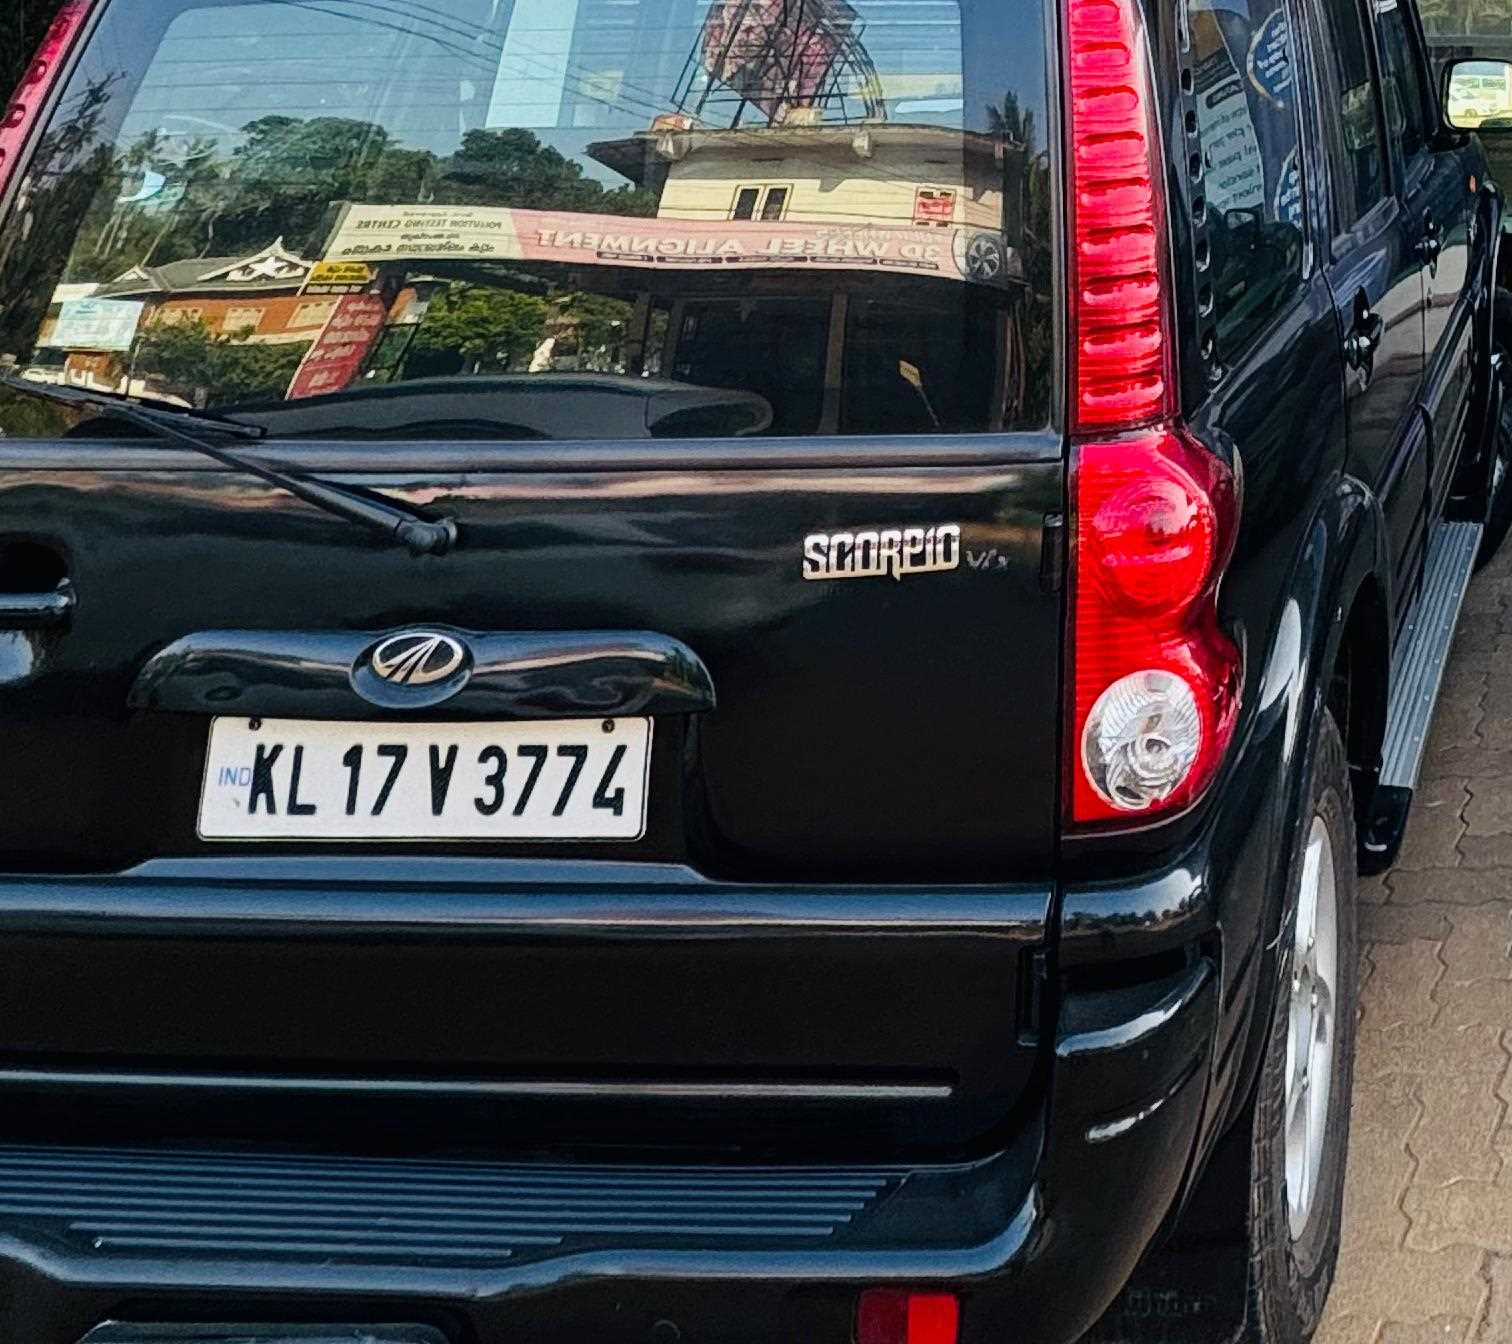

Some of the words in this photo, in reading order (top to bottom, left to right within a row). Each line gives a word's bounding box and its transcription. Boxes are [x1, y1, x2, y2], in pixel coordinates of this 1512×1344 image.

[803, 524, 960, 581] SCORPIO
[219, 767, 251, 787] IND
[248, 744, 316, 815] KL
[343, 744, 408, 815] 17
[429, 744, 458, 815] V
[474, 744, 627, 816] 3774
